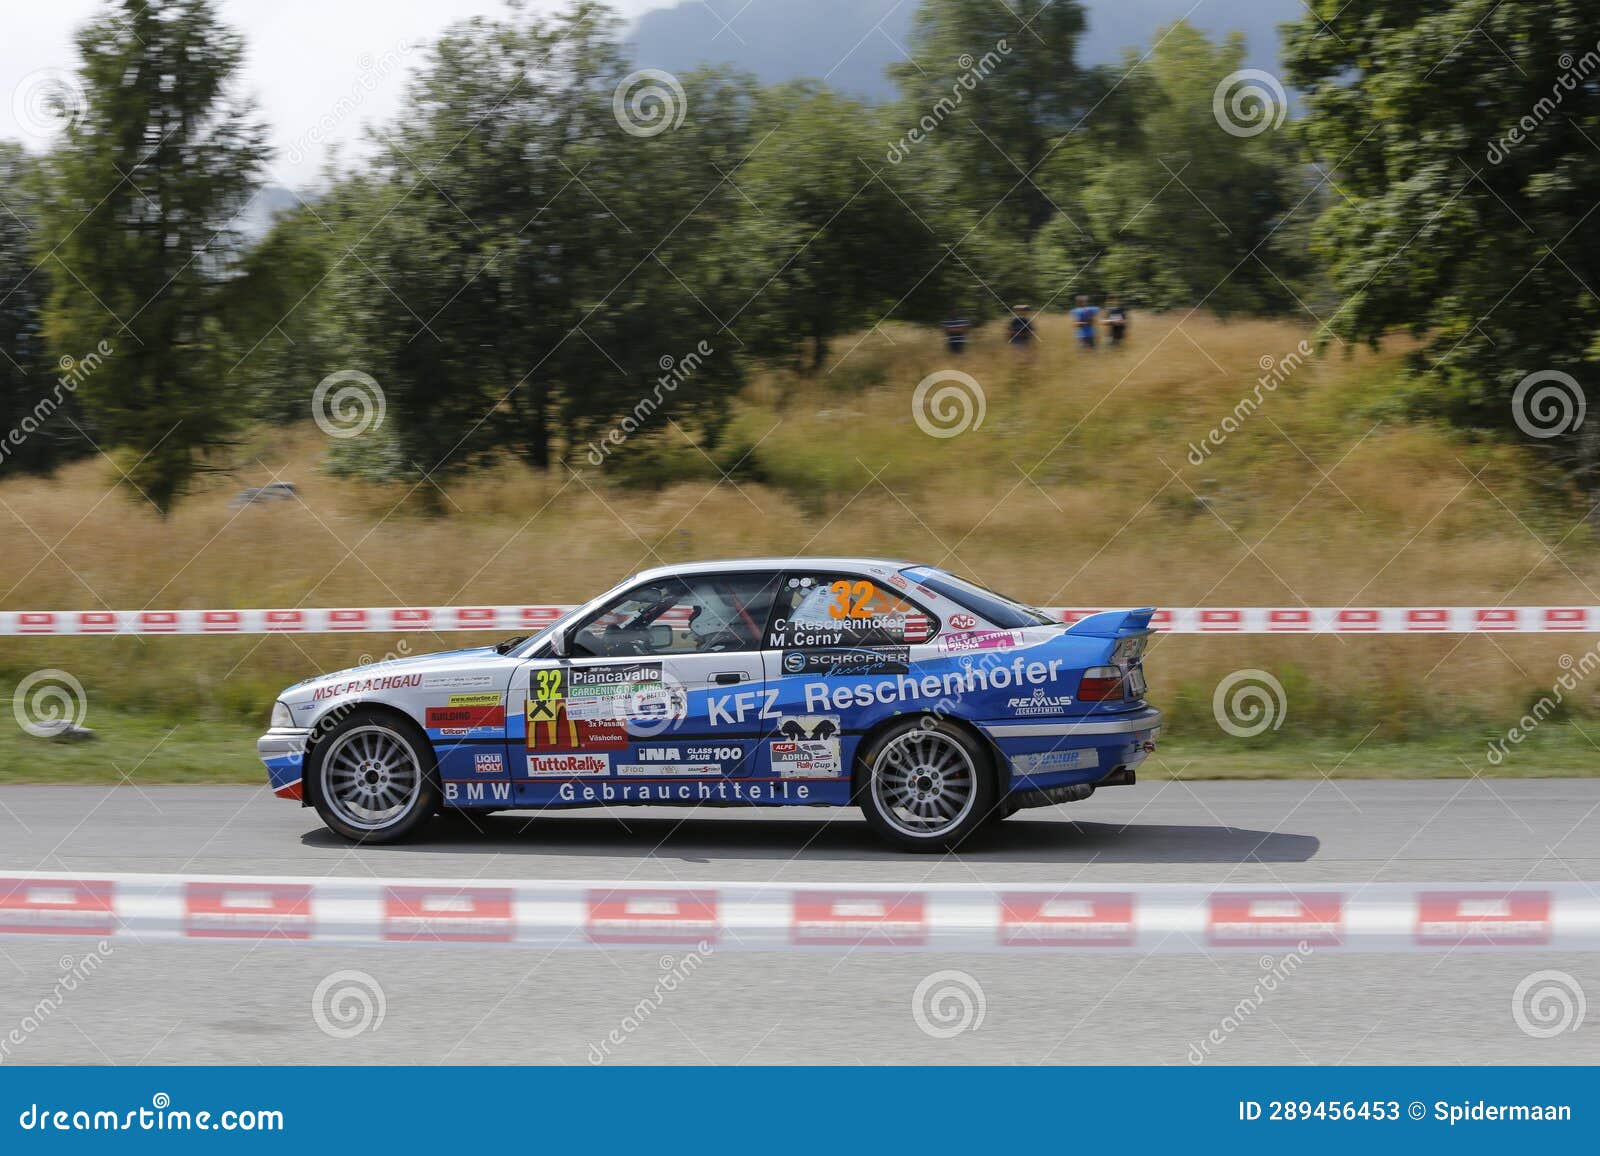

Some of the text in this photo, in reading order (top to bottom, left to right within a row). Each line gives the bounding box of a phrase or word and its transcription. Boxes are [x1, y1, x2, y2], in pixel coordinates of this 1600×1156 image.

[829, 580, 874, 620] 32
[774, 615, 904, 631] C. Reschenhofer
[794, 632, 842, 646] Cerny
[809, 653, 908, 665] SCHROFNER
[573, 668, 658, 685] Piancavallo
[312, 673, 422, 701] MSC-FLACHGAU
[536, 670, 562, 701] 32
[707, 655, 1063, 727] KFZ Reschenhofer
[1007, 696, 1072, 708] REMUS
[476, 754, 502, 763] LIQUI
[687, 747, 713, 755] CLASS
[713, 747, 742, 761] 100
[781, 753, 810, 761] ADRIA
[476, 762, 502, 771] MOLY
[444, 781, 810, 801] BMW Gebrauchtteile
